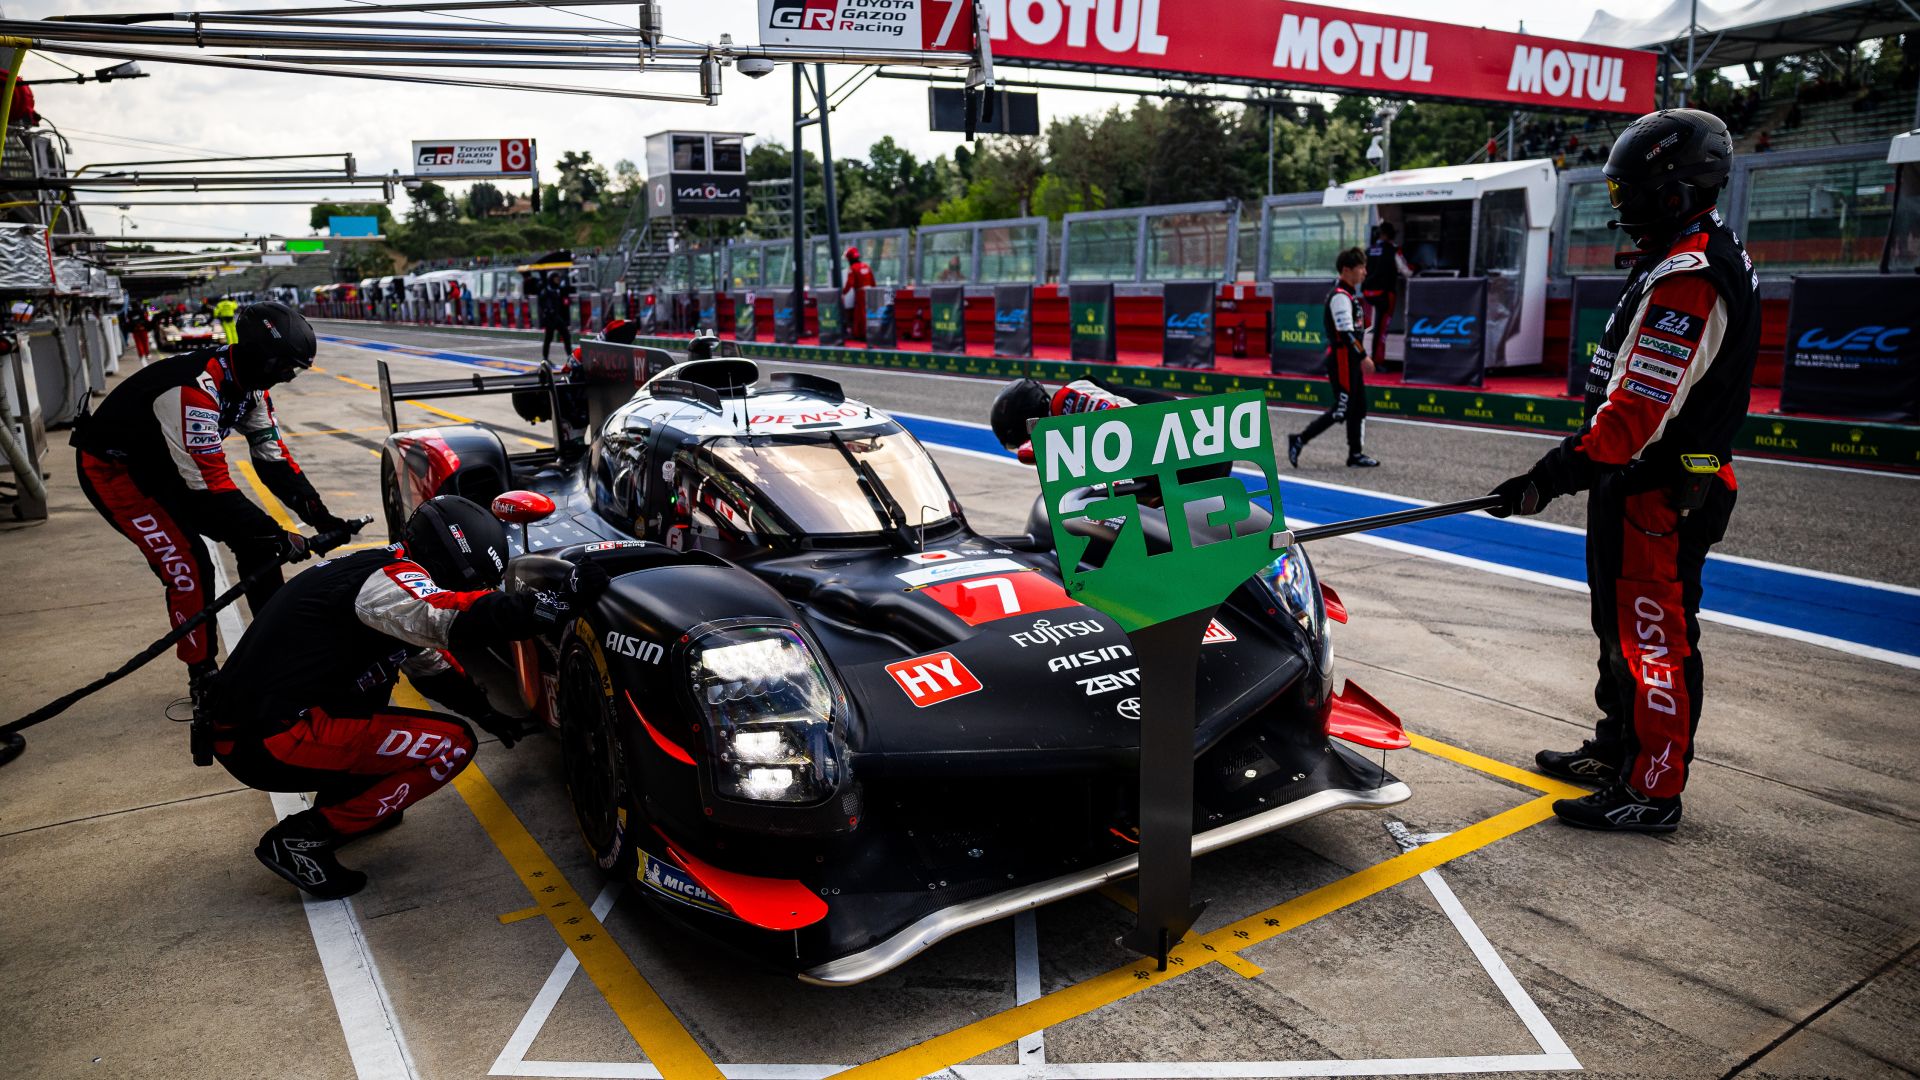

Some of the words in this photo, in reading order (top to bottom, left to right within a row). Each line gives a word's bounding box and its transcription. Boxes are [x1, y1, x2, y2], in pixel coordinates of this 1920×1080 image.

[772, 8, 834, 30] GR
[842, 9, 906, 21] GAZOO
[933, 0, 964, 46] 7
[987, 0, 1168, 55] OTUL
[839, 21, 904, 36] Racing
[1273, 13, 1433, 82] MOTUL
[1507, 45, 1626, 102] MOTUL
[420, 153, 453, 165] GR
[507, 140, 526, 170] 8
[678, 186, 740, 199] IMOLA
[1281, 330, 1321, 344] ROLEX
[1411, 315, 1477, 336] WEC
[1797, 326, 1911, 352] WEC
[634, 357, 646, 381] HY
[1795, 359, 1860, 369] CHAMPIONSHIP
[1635, 385, 1668, 400] MICHELIN
[749, 408, 858, 424] DENSO
[1514, 413, 1545, 423] ROLEX
[1152, 401, 1261, 465] DRV
[1755, 435, 1798, 448] ROLEX
[1046, 420, 1133, 483] ON
[1831, 442, 1879, 456] ROLEX
[132, 513, 195, 592] DENSO
[586, 541, 615, 551] GR
[487, 546, 504, 573] uvex
[961, 577, 1021, 614] 7
[1009, 619, 1105, 647] FUJITSU
[606, 630, 664, 665] AISIN
[1047, 644, 1132, 672] AISIN
[1634, 596, 1677, 715] DENSO
[895, 658, 962, 698] HY
[664, 875, 715, 901] MICH
[1169, 957, 1184, 966] 10
[1133, 970, 1150, 980] 20
